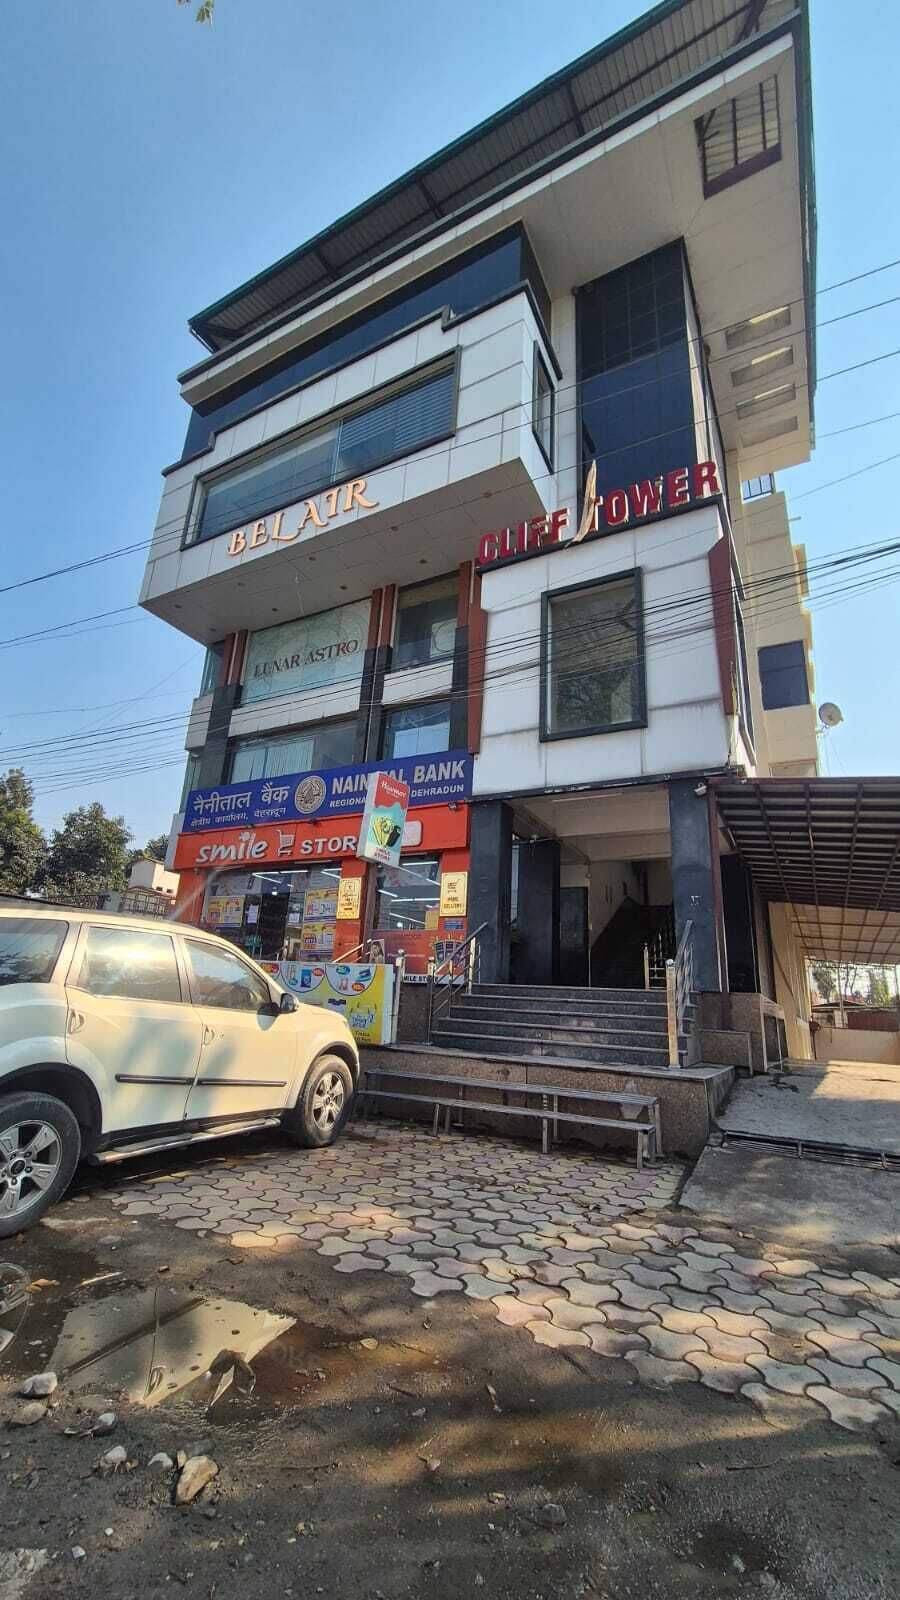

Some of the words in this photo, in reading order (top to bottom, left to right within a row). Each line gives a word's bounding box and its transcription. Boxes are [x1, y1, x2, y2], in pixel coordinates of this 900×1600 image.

[477, 507, 570, 566] CLIFF
[586, 461, 723, 532] TOWER
[254, 654, 302, 679] LUNAR
[304, 639, 360, 666] ASTRO
[332, 768, 408, 795] NAINAL
[413, 759, 467, 784] BANK
[193, 792, 252, 815] नैनीताल
[261, 782, 291, 805] बैंक
[330, 796, 367, 808] REGIONA
[411, 784, 465, 798] DEHRADUN
[195, 832, 268, 863] smile
[300, 835, 358, 855] STOR
